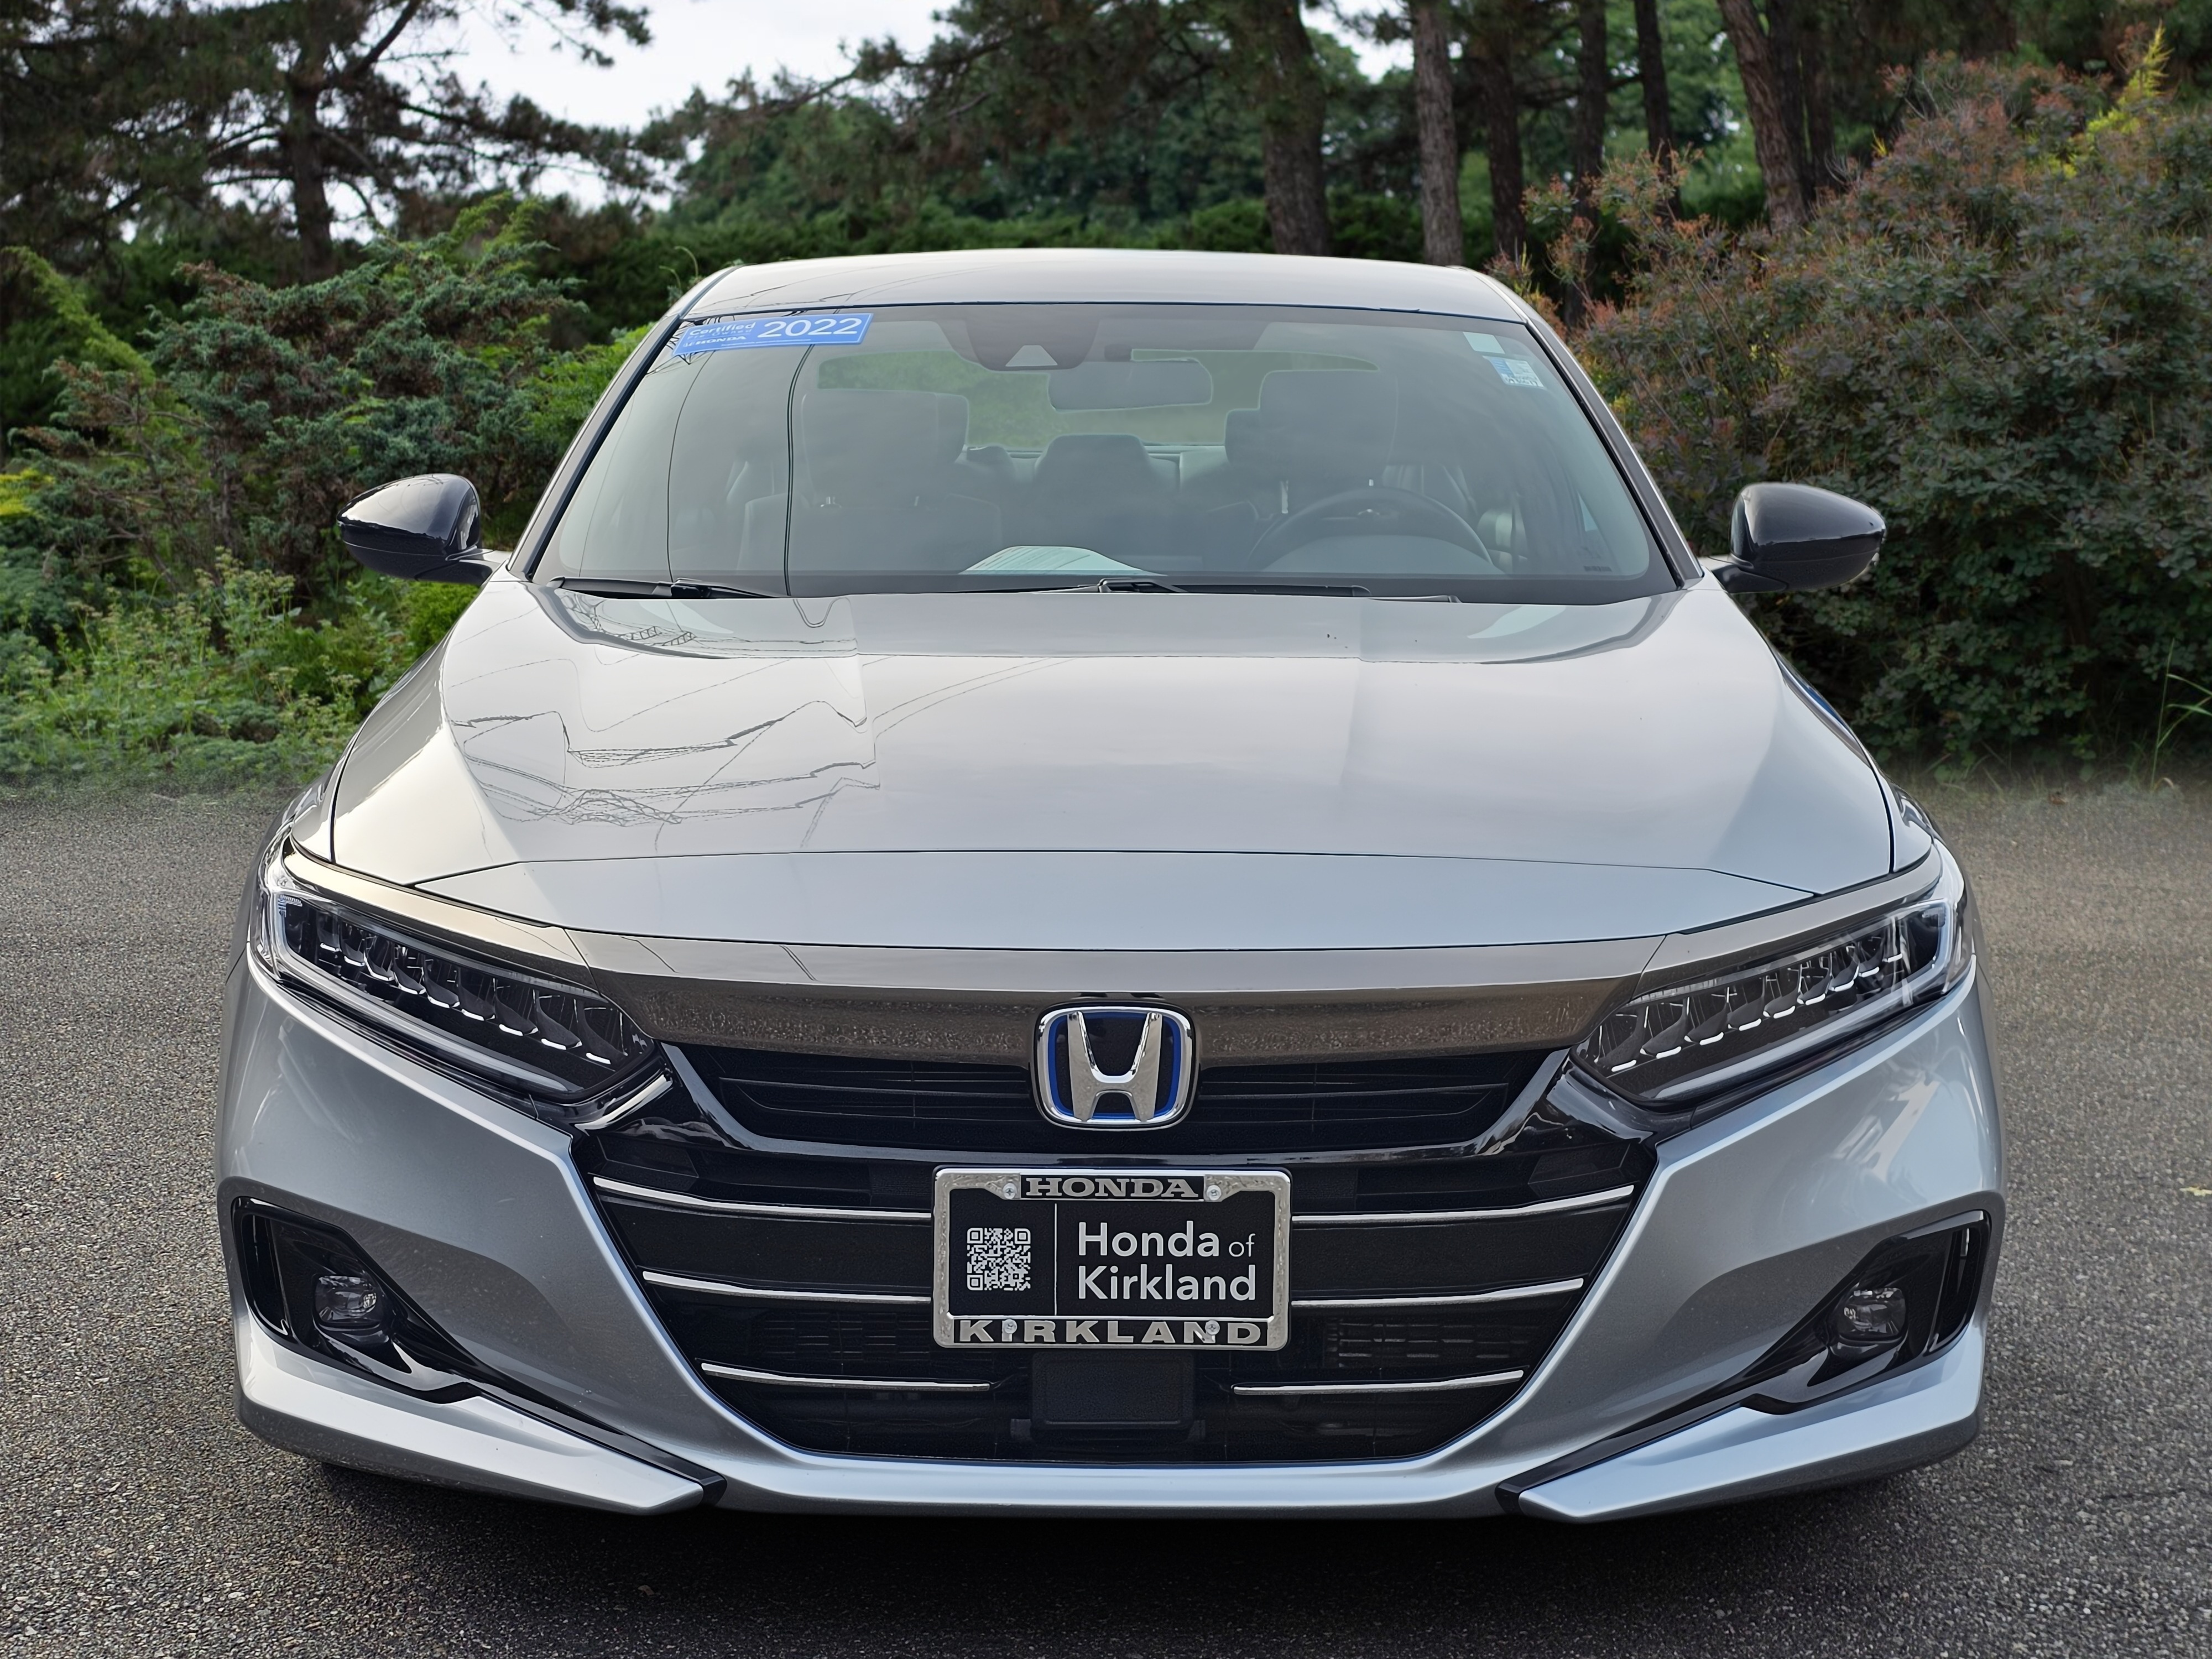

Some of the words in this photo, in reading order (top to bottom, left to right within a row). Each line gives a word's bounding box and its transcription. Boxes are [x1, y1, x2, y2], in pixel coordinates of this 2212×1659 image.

[690, 322, 756, 336] Certified
[757, 317, 862, 338] 2022
[696, 336, 747, 345] HONDA
[1026, 1177, 1199, 1198] HONDA
[1078, 1220, 1219, 1257] Honda
[1228, 1233, 1256, 1258] of
[1078, 1264, 1256, 1301] Kirkland
[959, 1319, 1261, 1344] KIRKLAND
